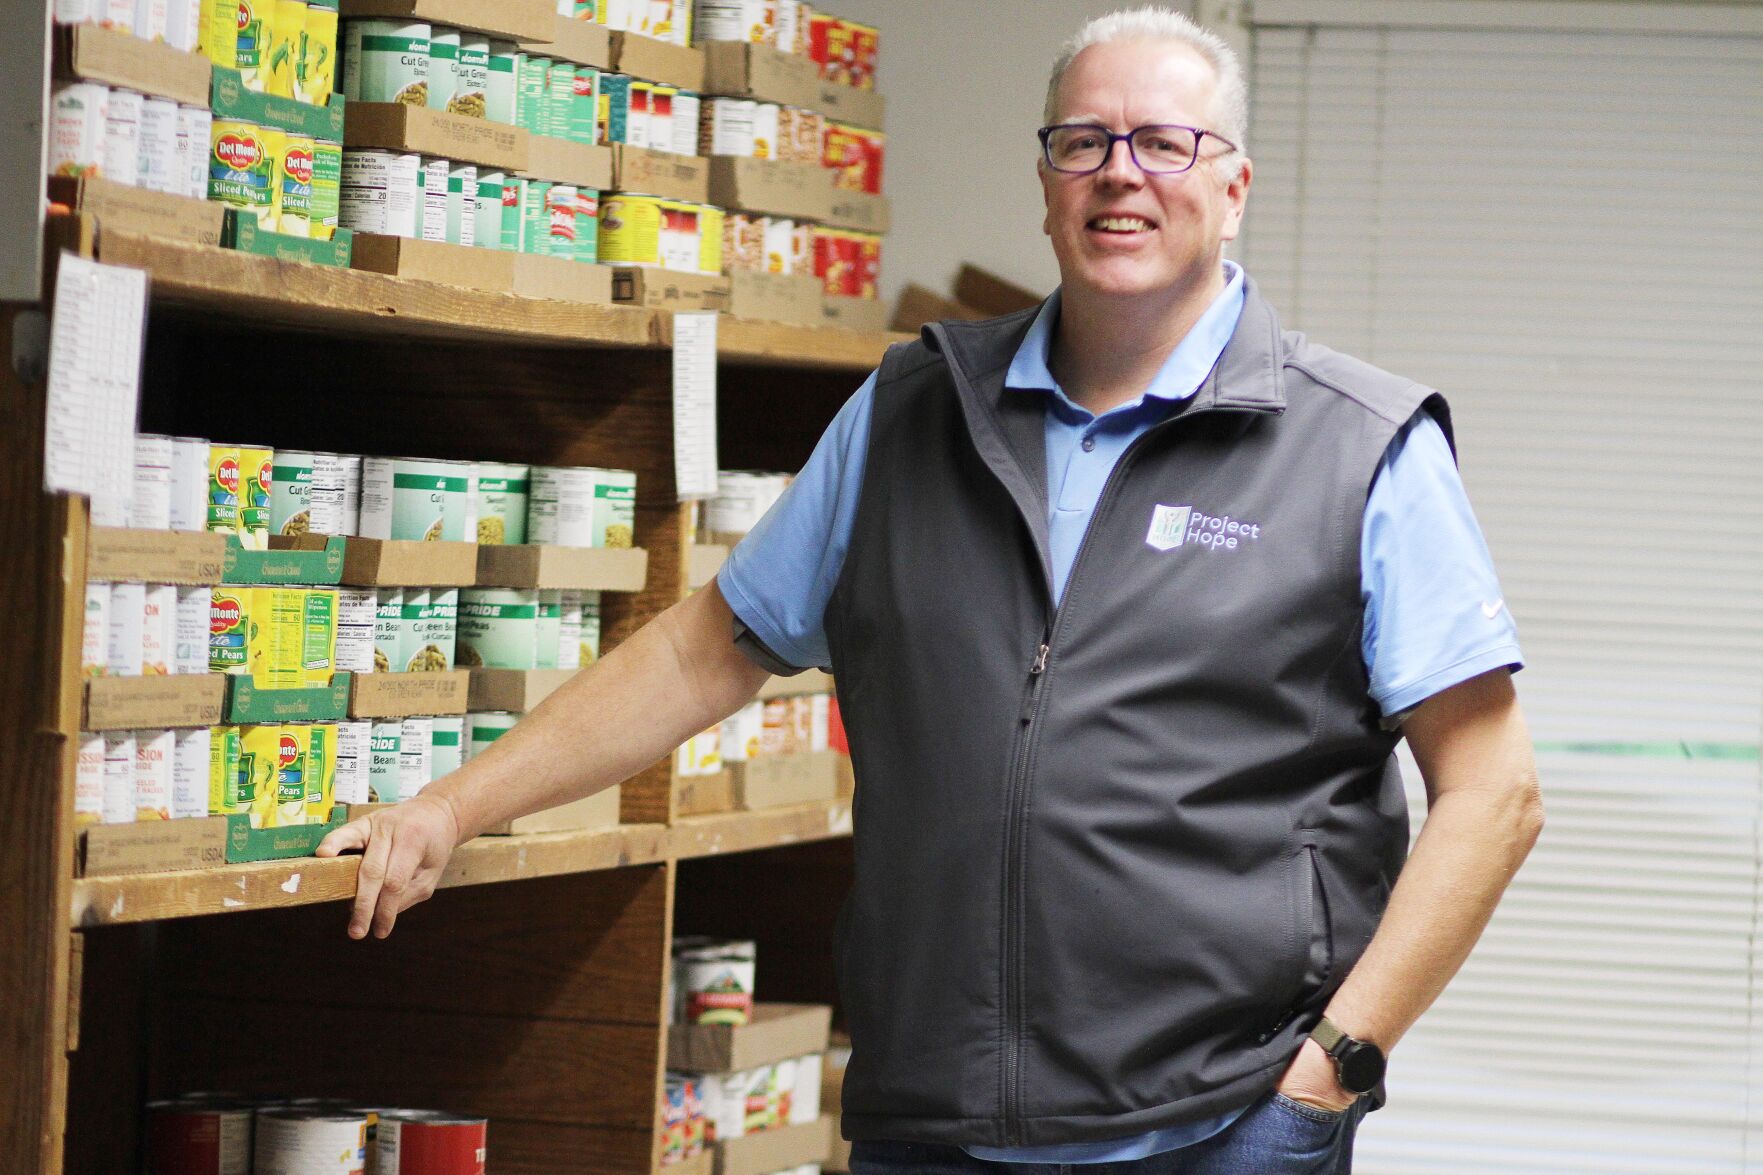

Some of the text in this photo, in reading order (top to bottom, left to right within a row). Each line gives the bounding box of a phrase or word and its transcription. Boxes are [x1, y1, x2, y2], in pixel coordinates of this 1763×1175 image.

[219, 142, 234, 153] Del
[286, 157, 300, 168] Del
[214, 183, 241, 194] Sliced
[282, 196, 305, 207] Sliced
[220, 469, 231, 479] Del
[289, 486, 302, 495] Cut
[216, 508, 235, 518] Sliced
[1189, 512, 1260, 538] Project
[1186, 527, 1238, 550] Hope
[222, 648, 243, 659] Pears
[279, 786, 300, 795] Pears
